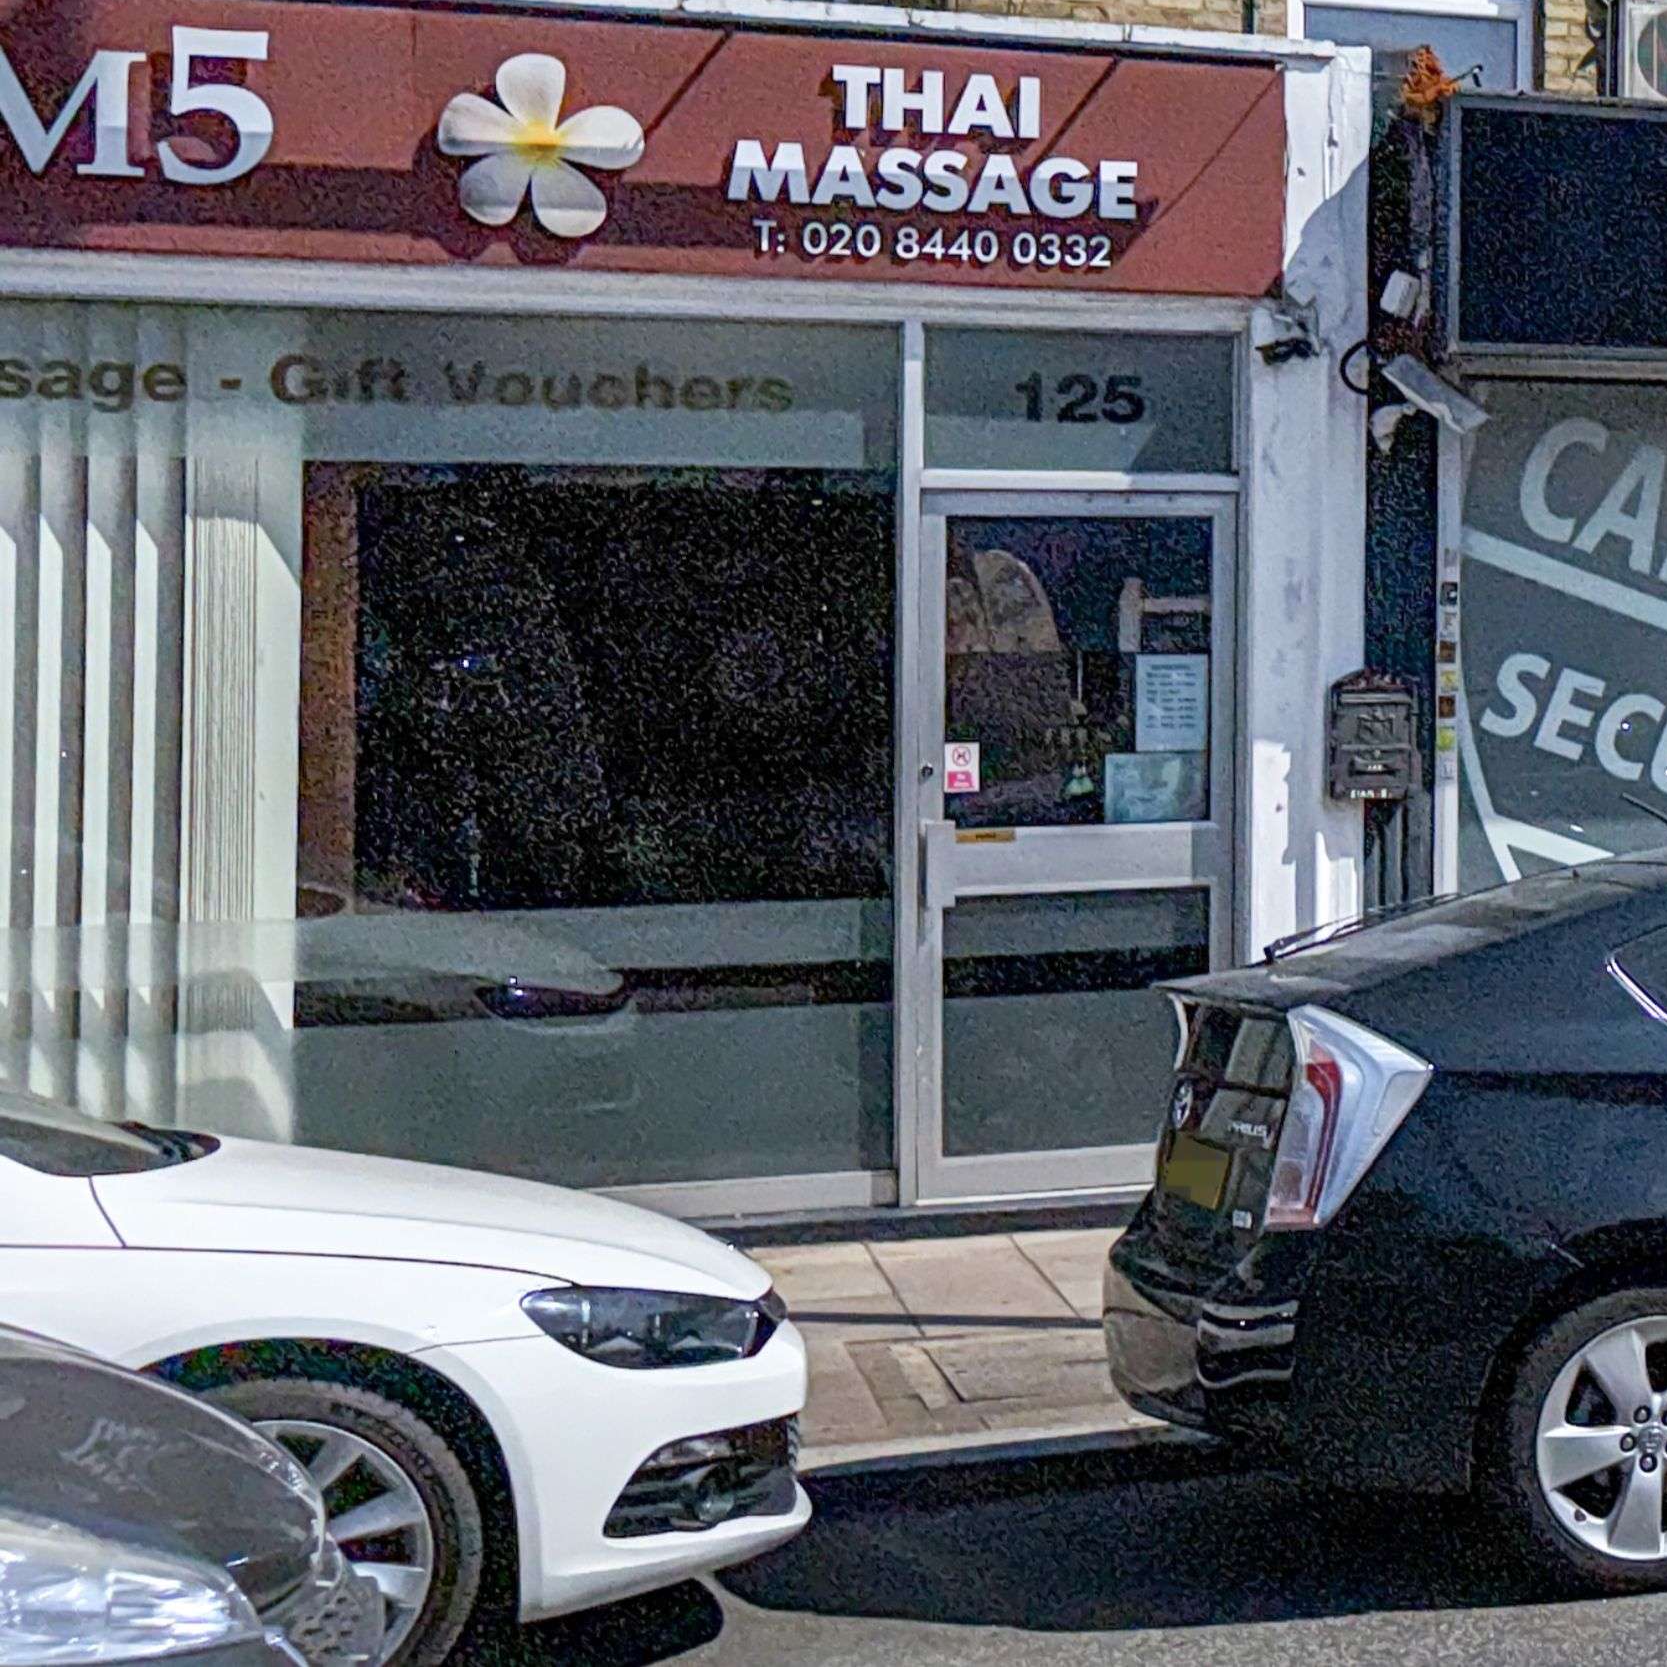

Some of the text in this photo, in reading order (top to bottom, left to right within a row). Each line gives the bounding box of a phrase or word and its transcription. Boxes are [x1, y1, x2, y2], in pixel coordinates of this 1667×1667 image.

[833, 65, 1040, 138] THAI
[727, 139, 1138, 219] MASSAGE
[753, 219, 1111, 266] T: 020 8440 0332
[270, 354, 407, 406] Gift
[443, 360, 793, 412] Vouchers
[1016, 371, 1145, 424] 125
